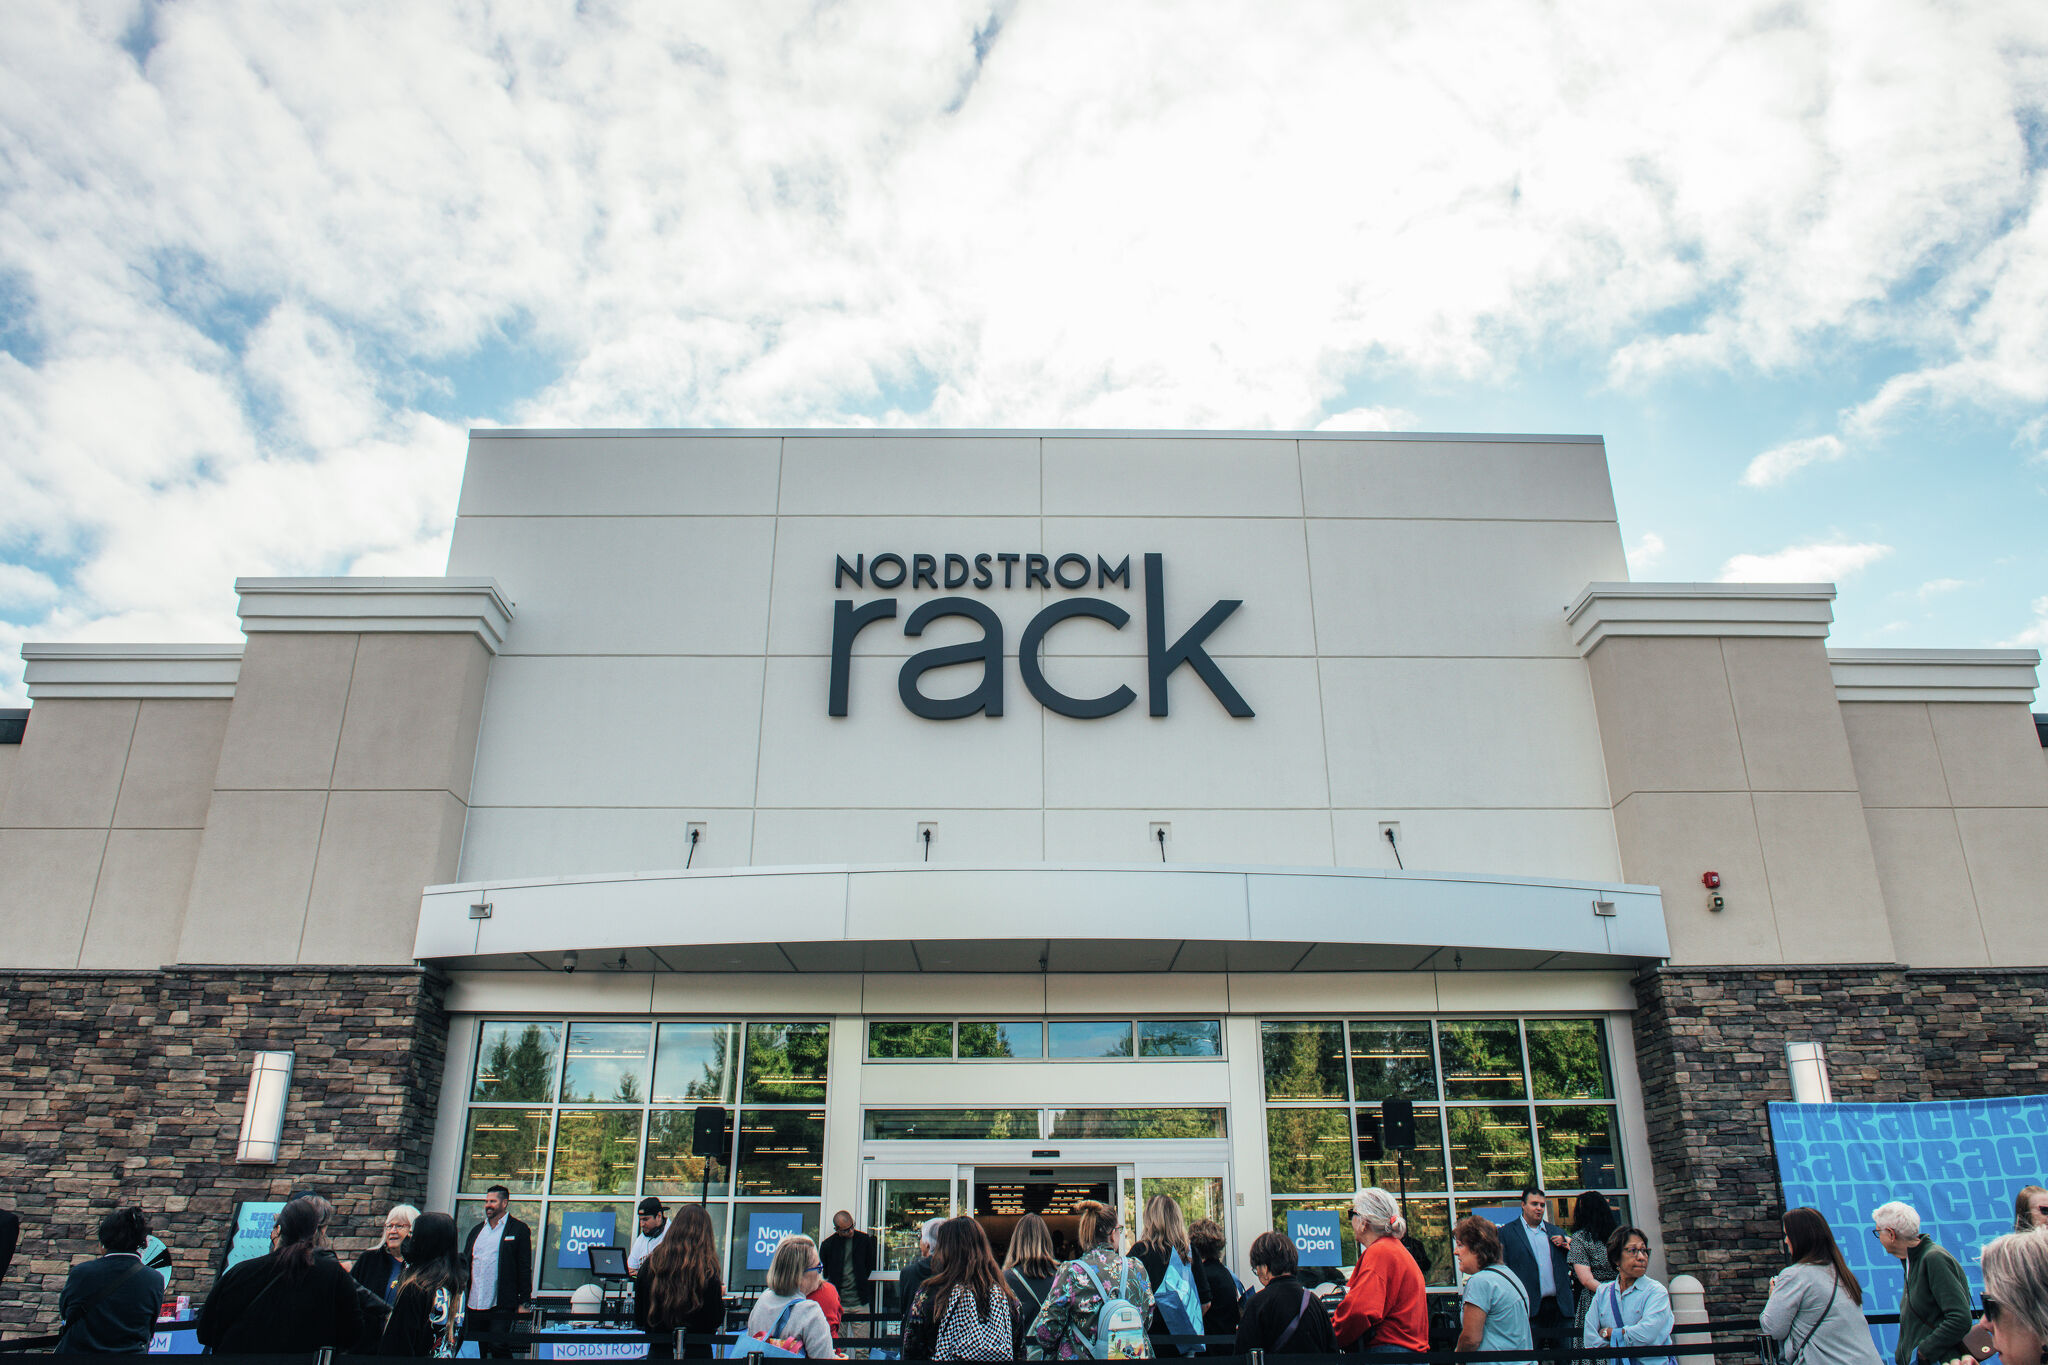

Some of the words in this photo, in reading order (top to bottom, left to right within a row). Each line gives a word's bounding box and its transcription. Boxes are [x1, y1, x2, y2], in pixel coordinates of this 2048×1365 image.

[834, 553, 1131, 589] NORDSTROM
[828, 552, 1256, 721] rack
[570, 1225, 605, 1238] Now
[758, 1226, 793, 1240] Now
[1296, 1223, 1332, 1237] Now
[754, 1240, 778, 1257] Op
[1295, 1237, 1335, 1253] Open
[556, 1343, 644, 1358] NORDSTROM
